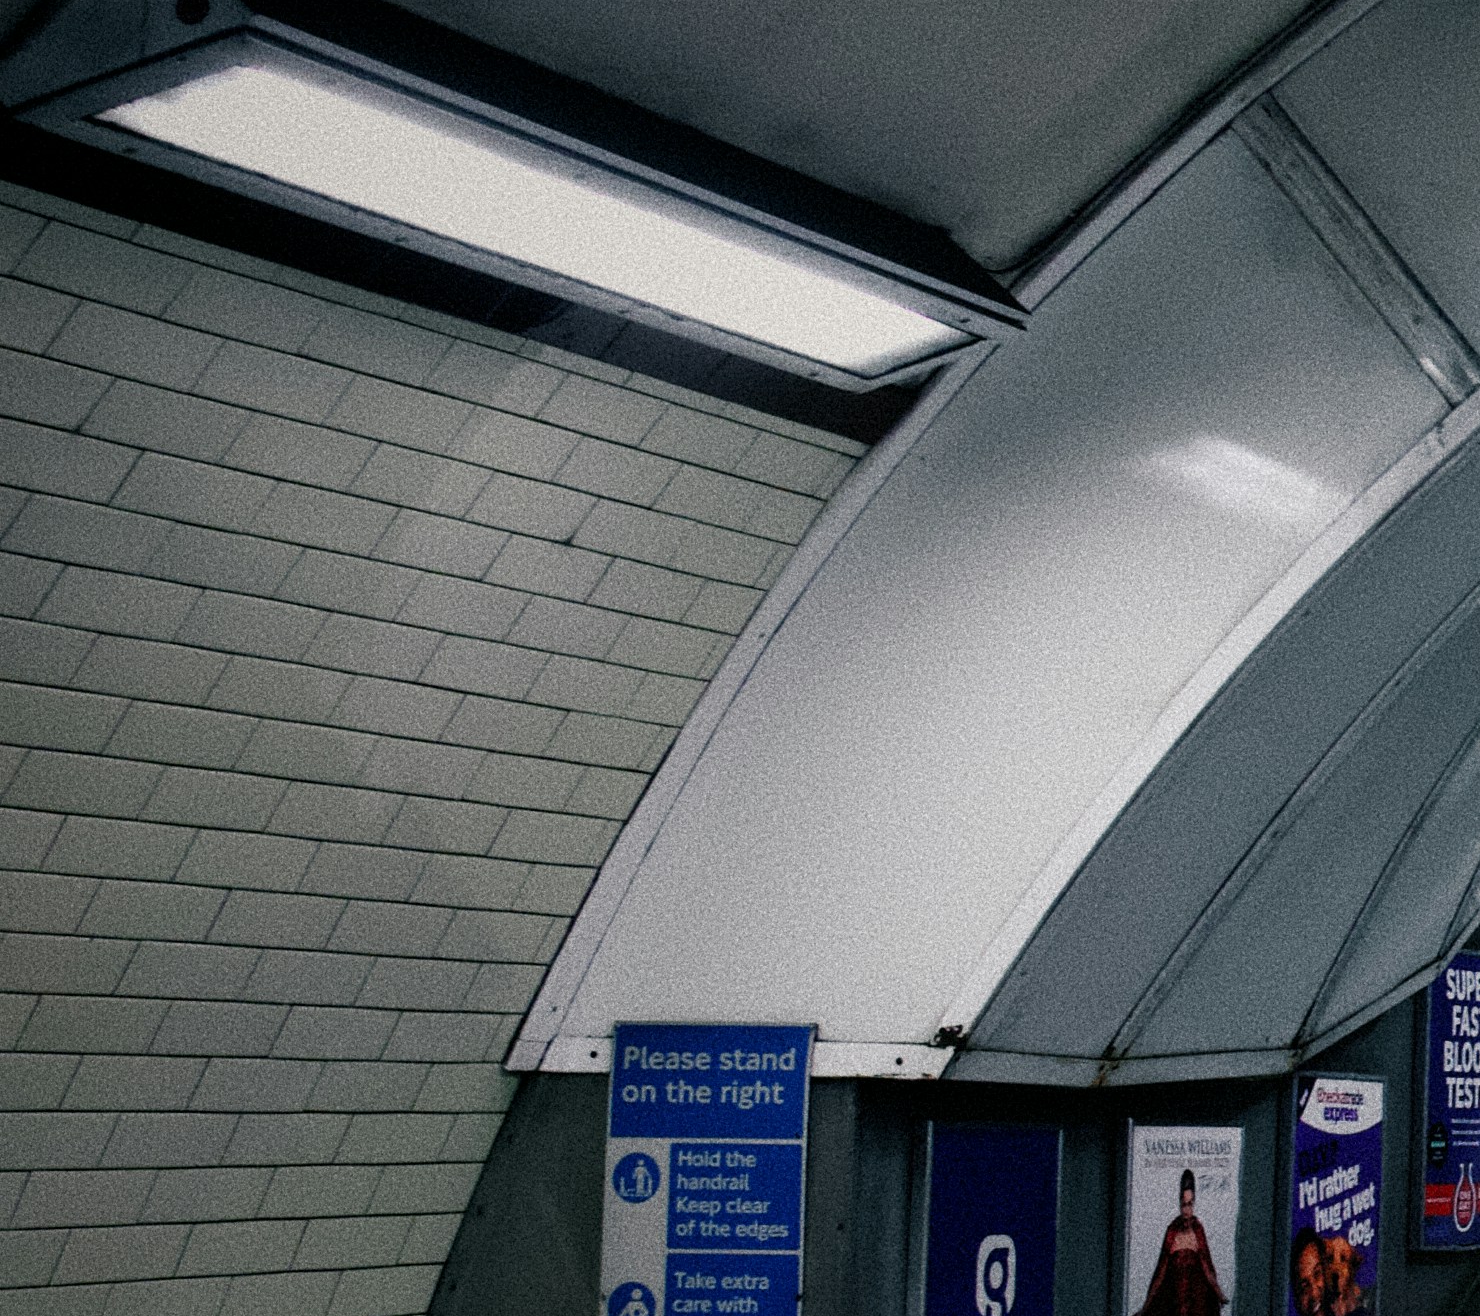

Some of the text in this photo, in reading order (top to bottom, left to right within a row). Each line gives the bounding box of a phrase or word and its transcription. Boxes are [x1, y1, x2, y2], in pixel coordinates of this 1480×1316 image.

[623, 1046, 797, 1072] Please stand
[621, 1080, 786, 1111] on the right
[1324, 1107, 1359, 1124] express
[677, 1150, 758, 1169] Hold the
[675, 1173, 751, 1191] handrail
[1299, 1164, 1361, 1210] I'd rather
[675, 1196, 771, 1217] Keep clear
[1314, 1181, 1376, 1234] hug a wet
[675, 1219, 790, 1242] of the edges
[1348, 1217, 1376, 1248] dog.
[673, 1271, 770, 1291] Take extra
[671, 1296, 760, 1314] care with
